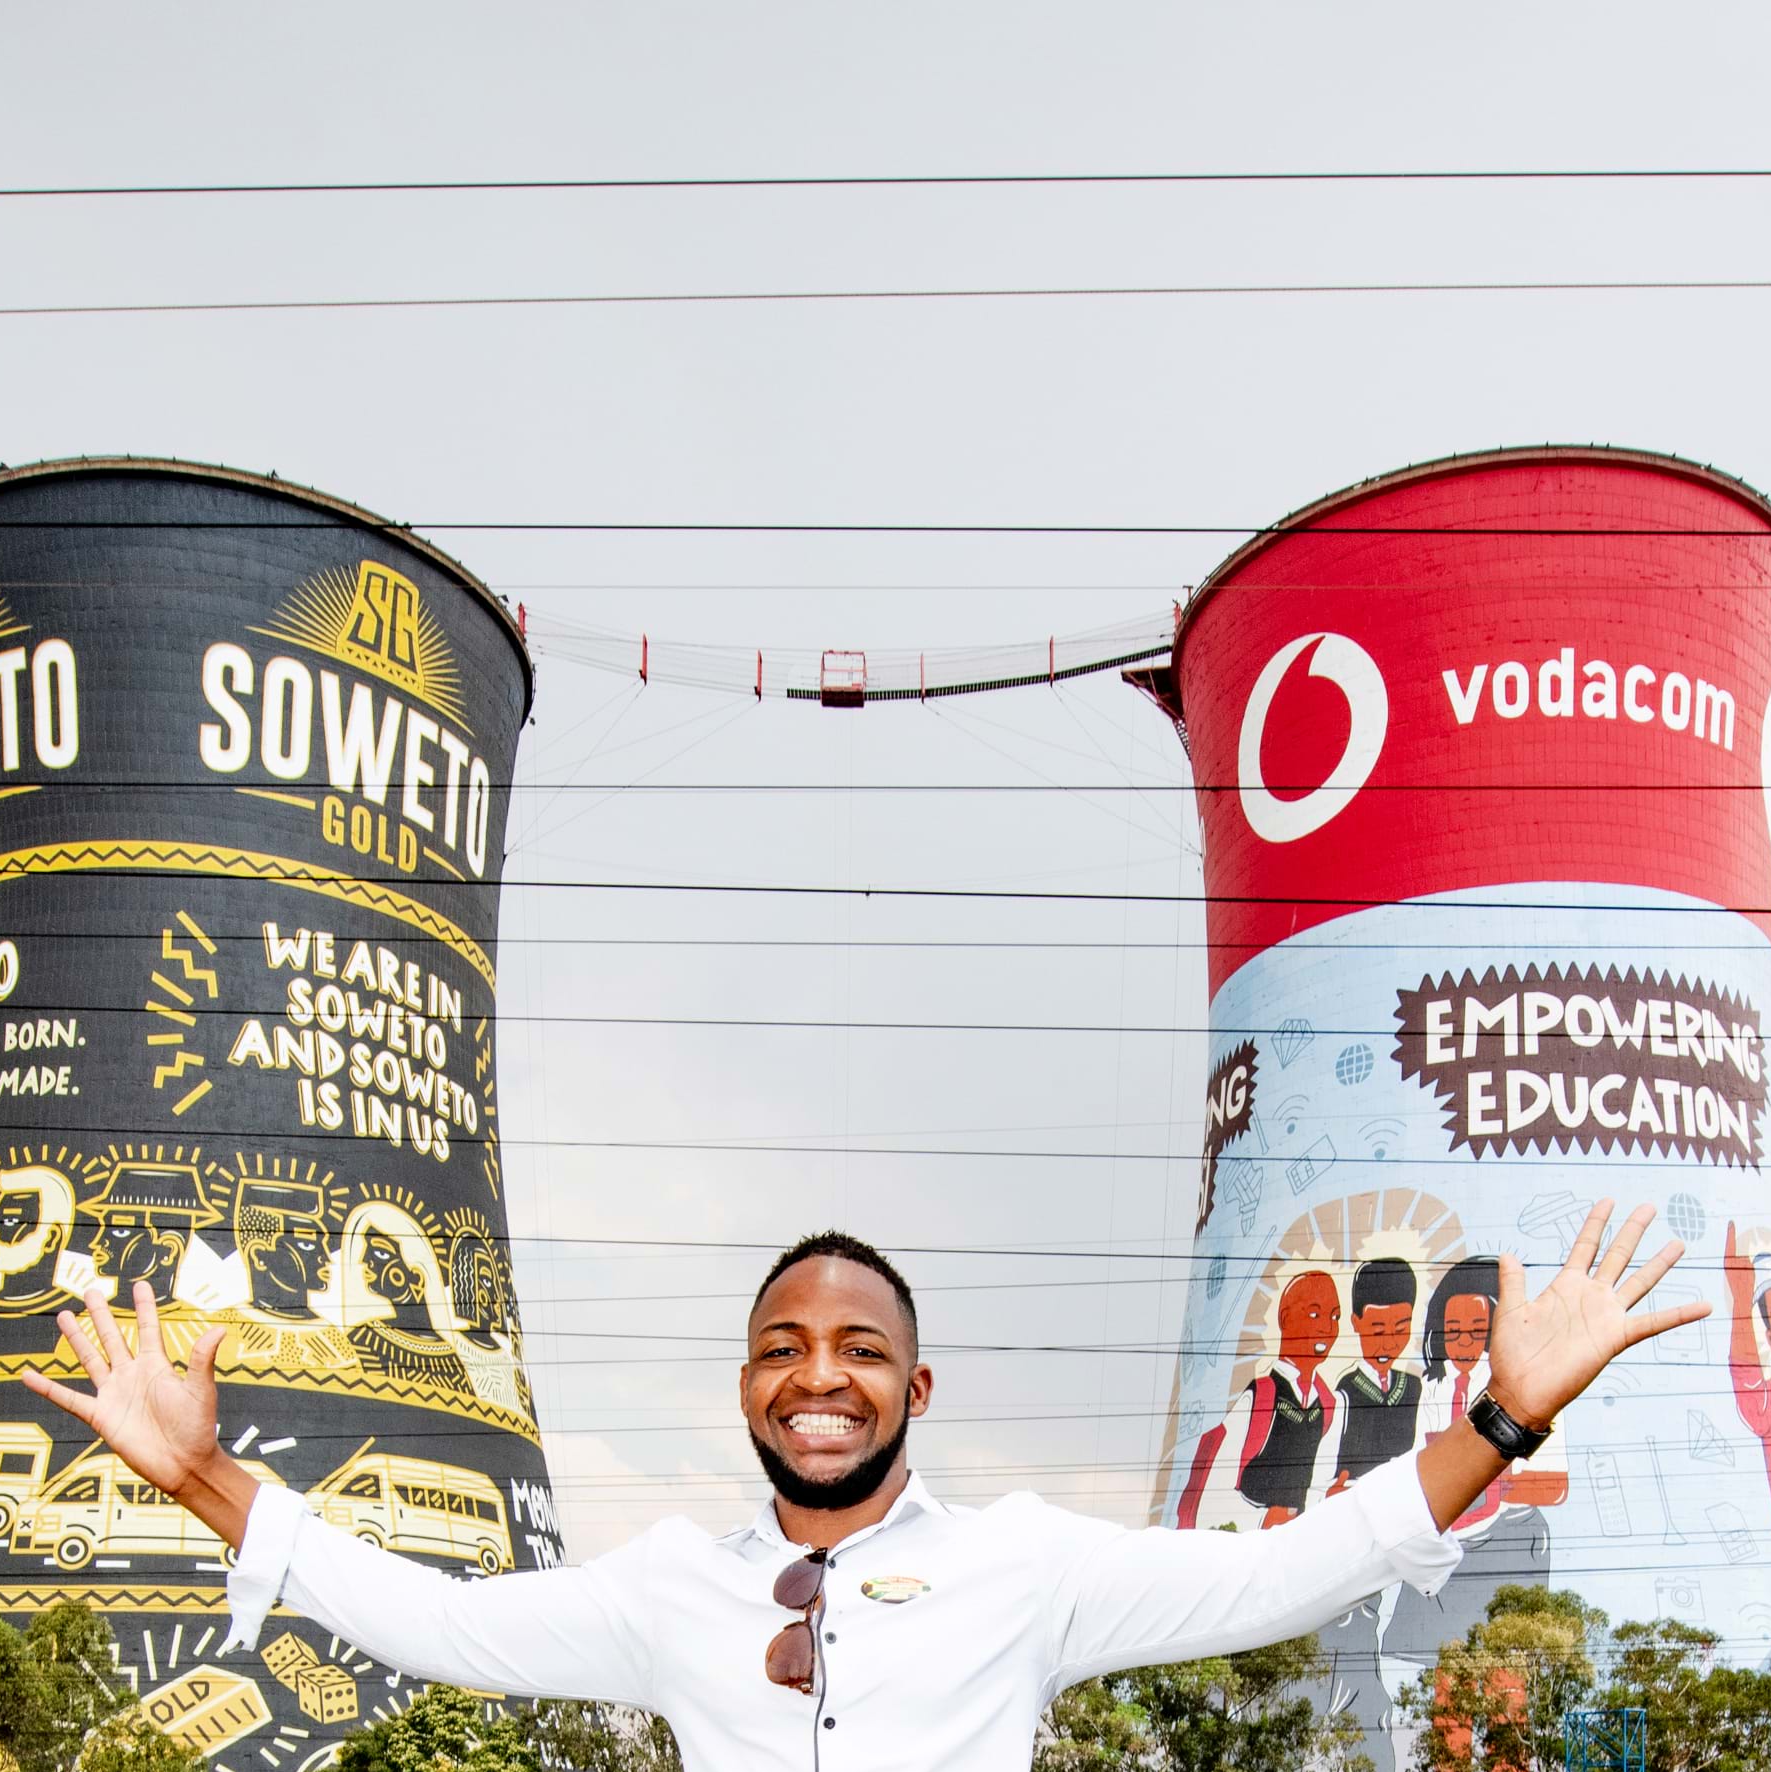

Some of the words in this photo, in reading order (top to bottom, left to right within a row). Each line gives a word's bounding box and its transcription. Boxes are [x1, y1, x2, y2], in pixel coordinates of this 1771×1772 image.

[1442, 647, 1735, 751] vodacom
[200, 642, 489, 878] SOWETO
[322, 795, 417, 873] GOLD
[262, 921, 337, 979] WE
[341, 941, 423, 1012] ARE
[429, 973, 462, 1034] IN
[3, 1018, 87, 1052] BORN.
[286, 977, 447, 1070] SOWETO
[1425, 992, 1762, 1083] EMPOWERING
[227, 1018, 346, 1080] AND
[349, 1042, 478, 1135] SOWETO
[297, 1078, 345, 1130] IS
[351, 1090, 403, 1148] IN
[406, 1106, 451, 1163] US
[1467, 1072, 1751, 1148] EDUCATION
[128, 1680, 211, 1736] GOLD
